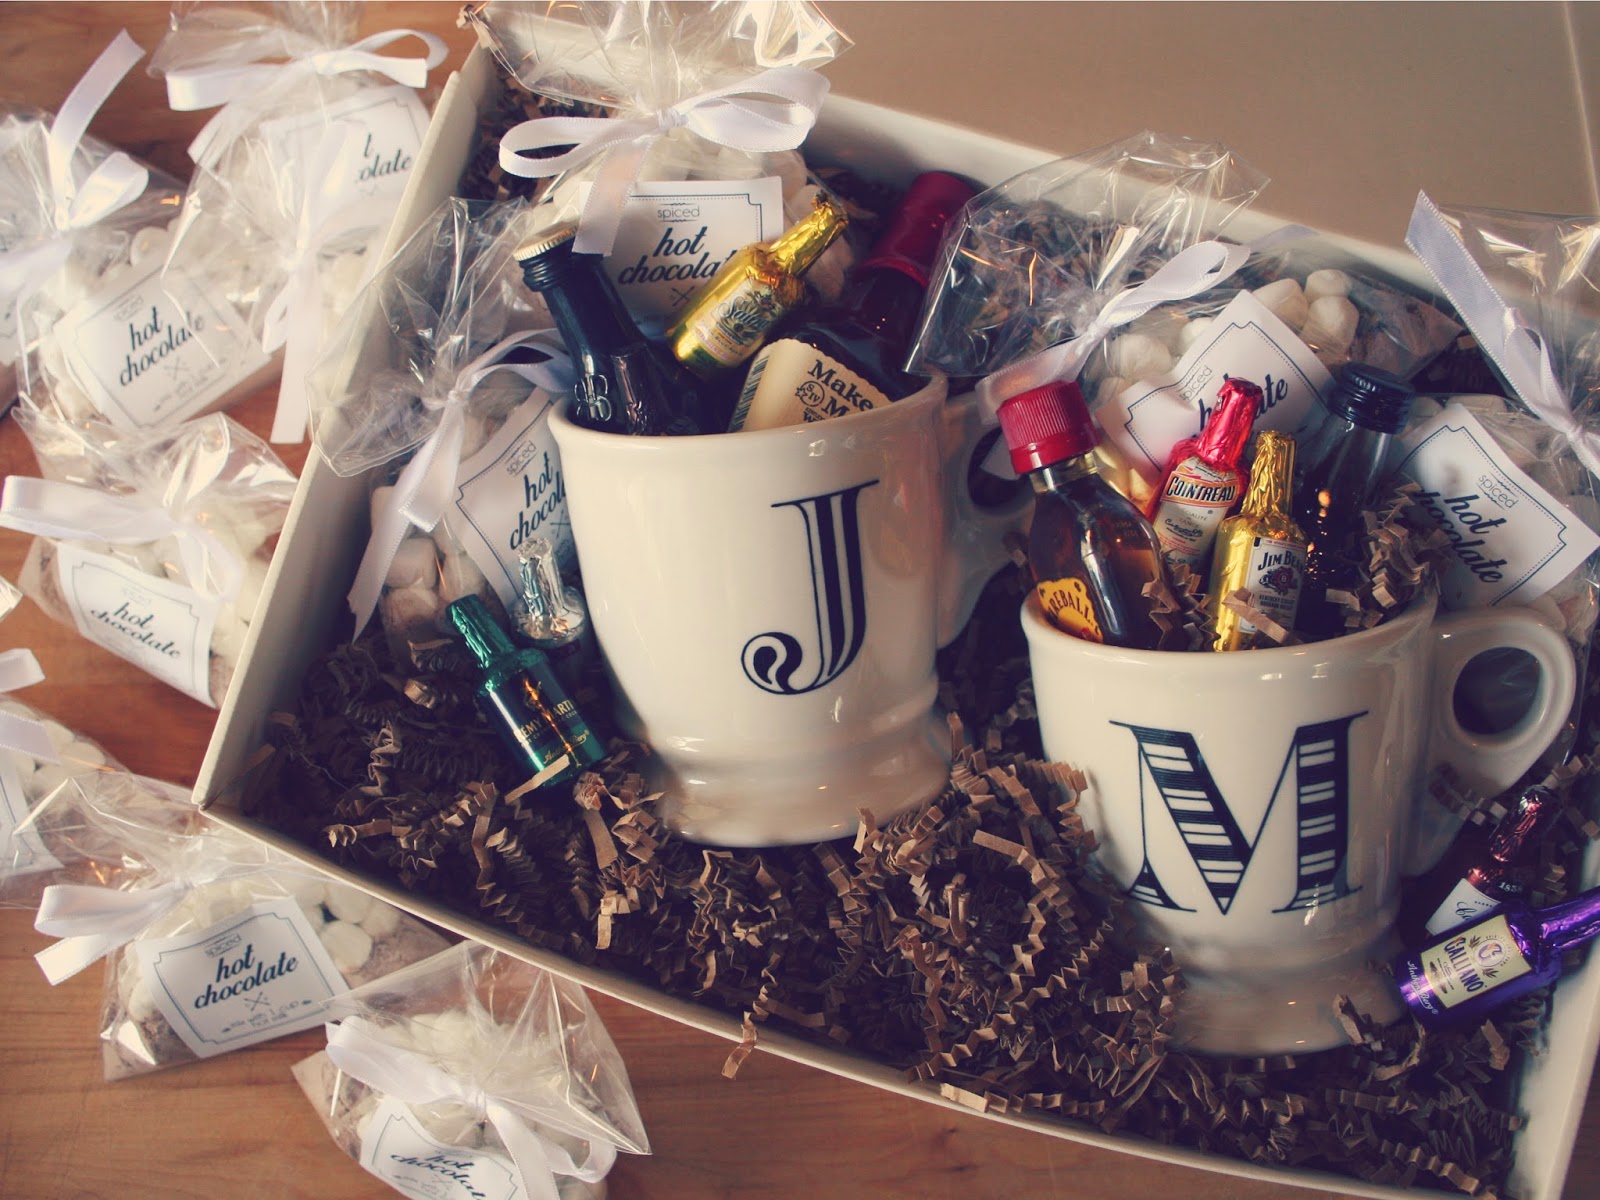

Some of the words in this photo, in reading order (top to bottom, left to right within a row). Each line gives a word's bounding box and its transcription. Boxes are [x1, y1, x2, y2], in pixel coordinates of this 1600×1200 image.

[657, 206, 700, 219] spiced
[653, 226, 708, 257] hot
[618, 250, 737, 284] chocola
[129, 306, 163, 351] hot
[808, 359, 874, 412] Make
[506, 440, 537, 475] spiced
[524, 451, 553, 508] hot
[1166, 476, 1236, 502] COINTREAU
[1479, 475, 1519, 508] spiced
[510, 471, 566, 550] chocol
[1443, 494, 1507, 534] hot
[1411, 491, 1508, 583] hocolate
[1258, 552, 1283, 571] JIM
[740, 479, 880, 696] J
[1046, 590, 1092, 623] IREBALL
[90, 609, 181, 658] chocolate
[114, 602, 154, 629] hot
[1109, 710, 1369, 915] M
[194, 951, 298, 1009] chocolate
[216, 943, 255, 983] hot
[1444, 936, 1485, 993] GALLIANO
[391, 1154, 488, 1200] chocolat
[425, 1154, 475, 1171] hot
